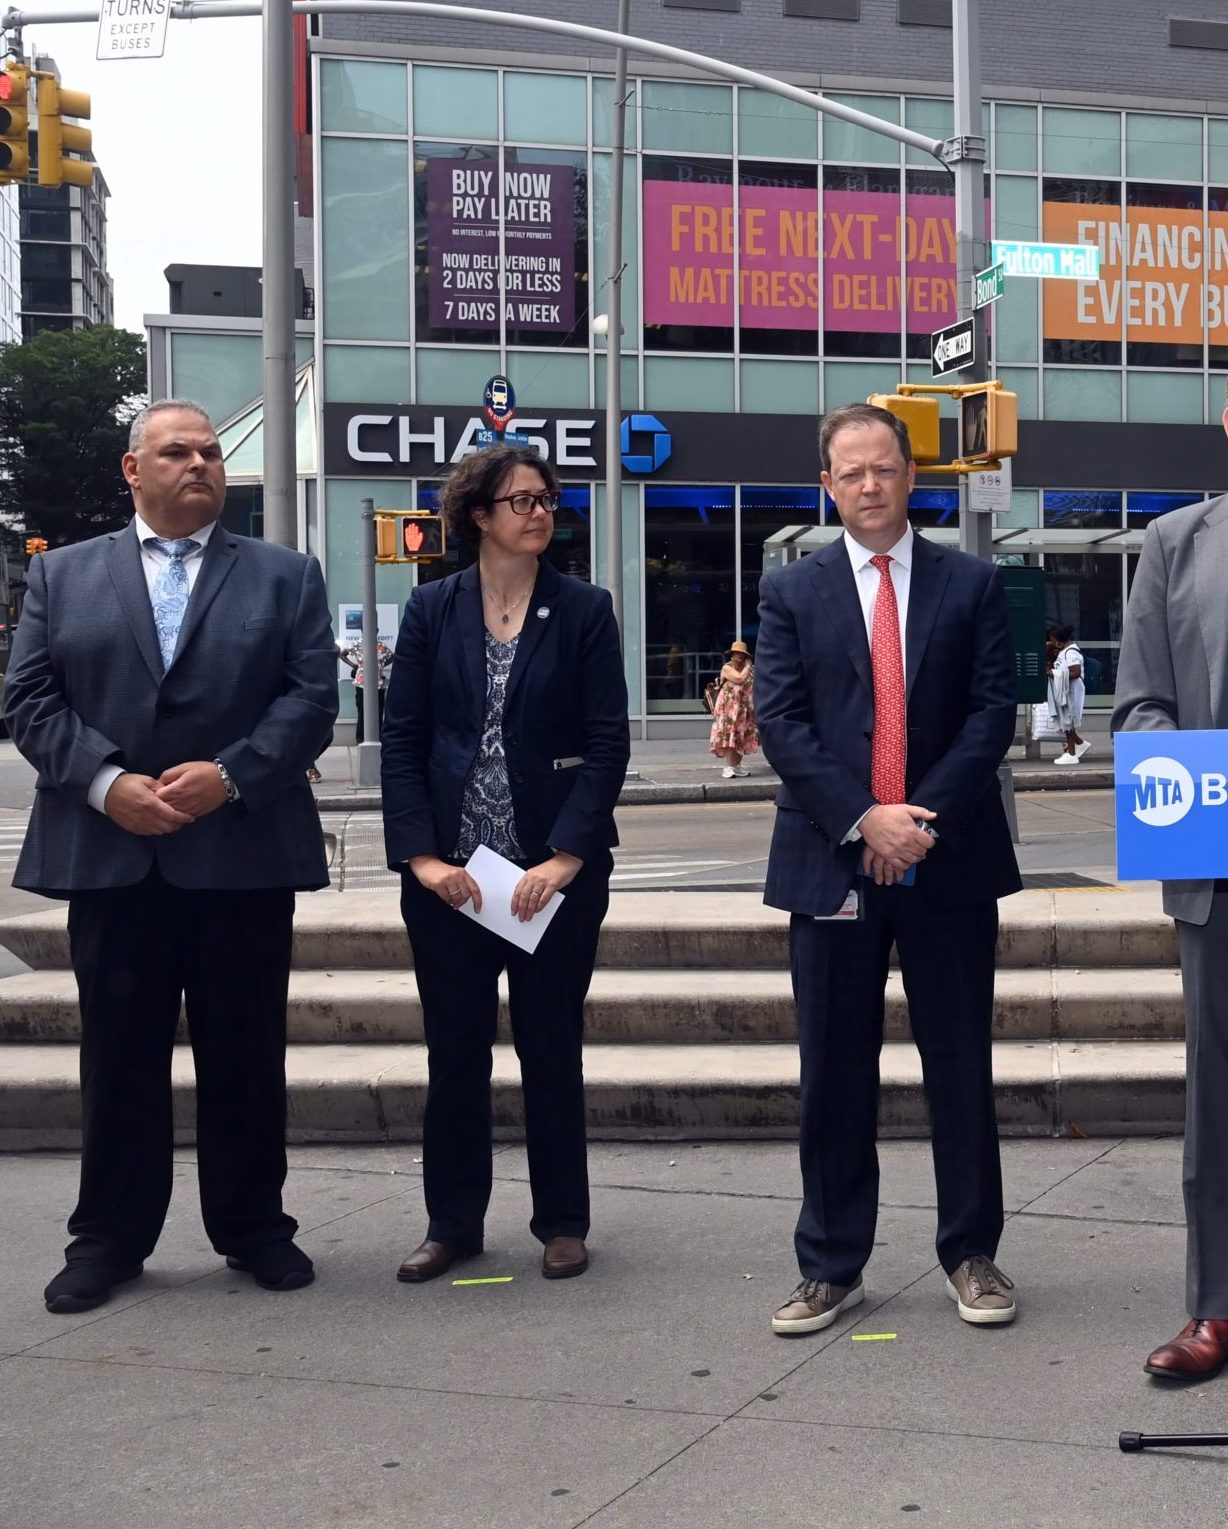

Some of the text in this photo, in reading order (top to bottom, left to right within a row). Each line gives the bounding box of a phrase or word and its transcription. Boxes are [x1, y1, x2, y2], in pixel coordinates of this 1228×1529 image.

[107, 0, 165, 16] TURNS
[111, 22, 155, 35] EXCEPT
[112, 37, 150, 50] BUSES
[452, 169, 551, 199] BUY NOW
[452, 197, 552, 222] PAY LATER
[452, 228, 459, 236] NO
[671, 203, 957, 264] FREE NEXT-DAY
[442, 253, 561, 272] NOW DELIVERING IN
[996, 247, 1096, 275] Fulton Mall
[443, 270, 561, 292] 2 DAYS OR LESS
[669, 266, 824, 309] MATTRESS
[977, 272, 997, 305] Bond
[444, 301, 561, 323] 7 DAYS A WEEK
[1077, 279, 1189, 327] EVERY
[938, 334, 969, 361] ONE WAY
[347, 414, 597, 466] CHASE
[1134, 775, 1184, 811] MTA
